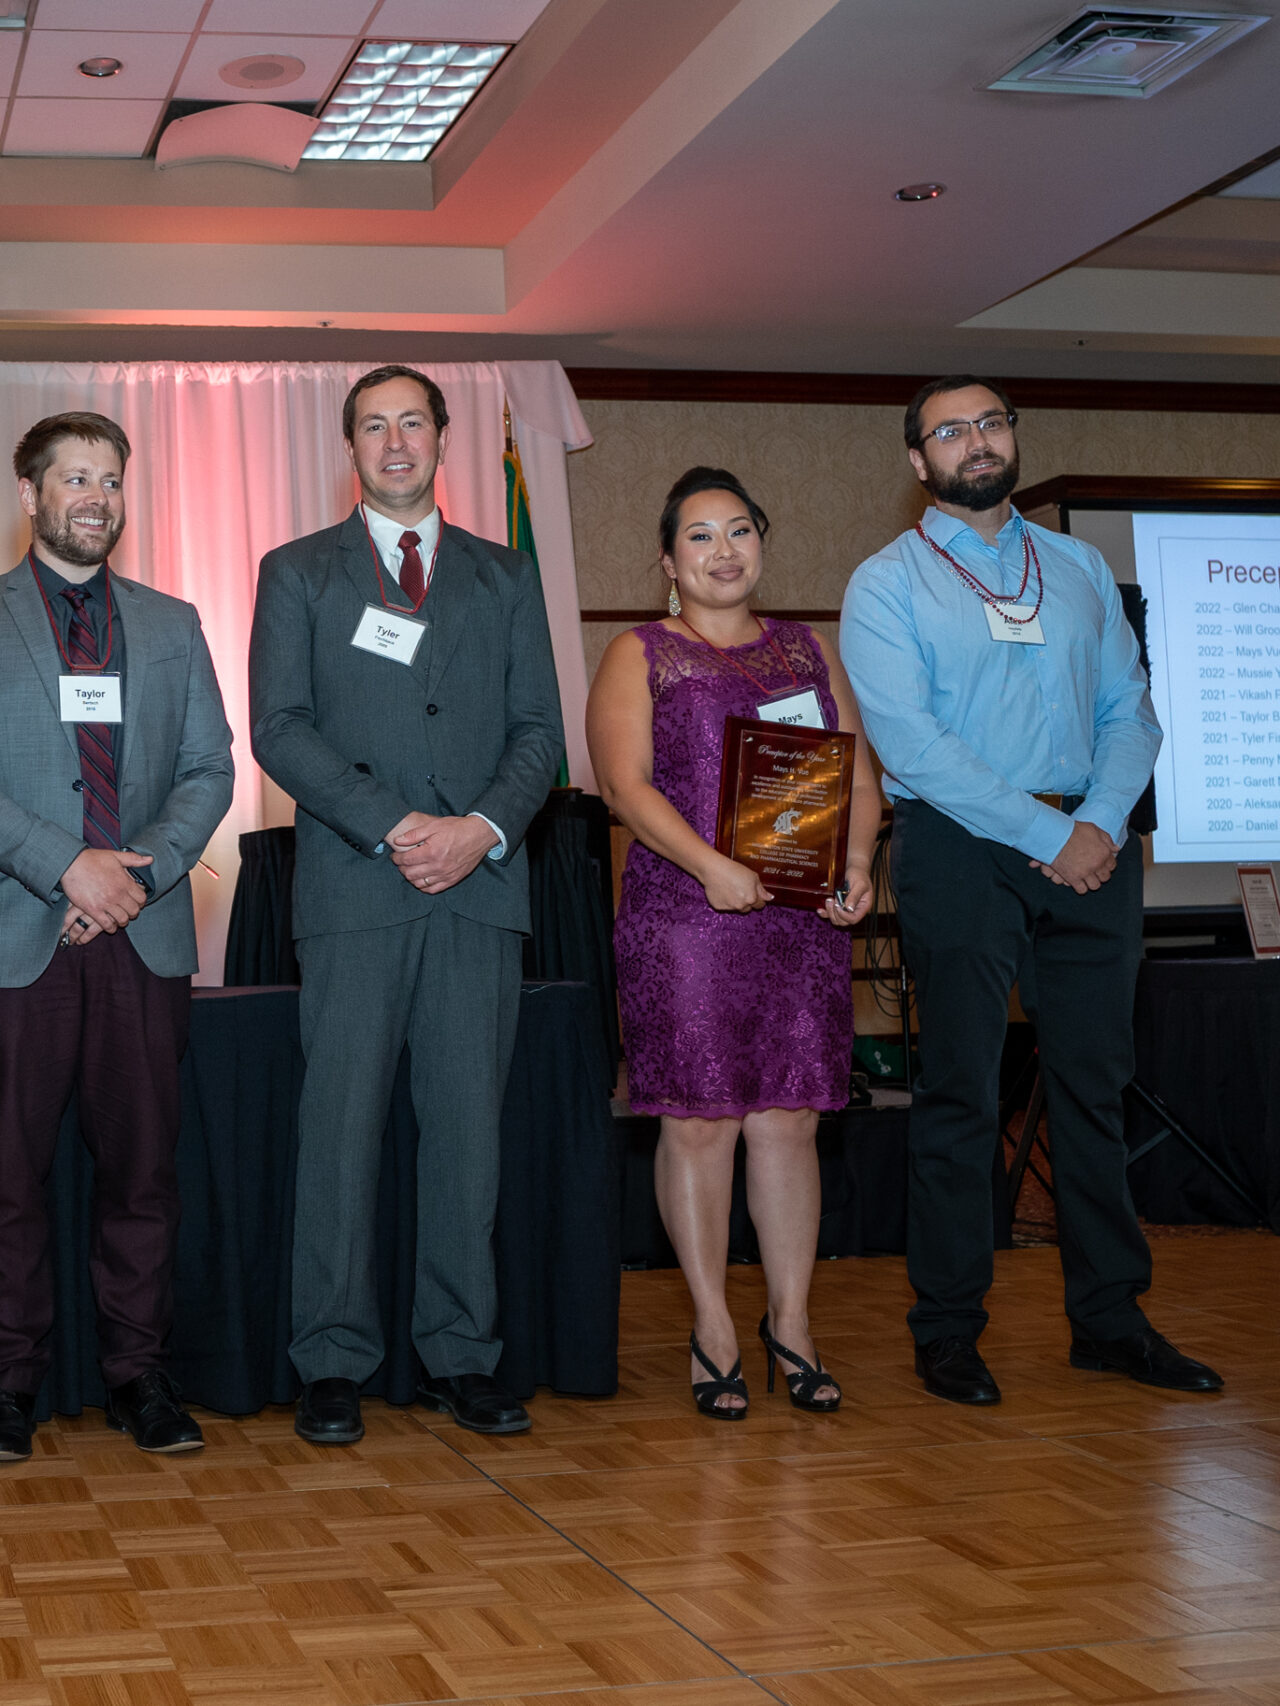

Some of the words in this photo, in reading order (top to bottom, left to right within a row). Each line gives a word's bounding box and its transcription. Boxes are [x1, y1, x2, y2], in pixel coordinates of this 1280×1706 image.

[1195, 602, 1221, 613] 2022
[1233, 602, 1257, 613] Glen
[377, 625, 400, 640] Tyler
[1197, 624, 1222, 635] 2022
[1234, 624, 1253, 635] Will
[1198, 646, 1224, 657] 2022
[1236, 646, 1263, 659] Mays
[1200, 667, 1225, 678] 2022
[1237, 667, 1273, 678] Mussie
[75, 689, 106, 699] Taylor
[1201, 689, 1225, 700] 2021
[1239, 689, 1272, 700] Vikash
[778, 713, 803, 725] Mays
[1202, 711, 1226, 722] 2021
[1240, 711, 1269, 724] Taylor
[1203, 733, 1228, 744] 2021
[1241, 732, 1265, 746] Tyler
[1204, 754, 1229, 766] 2021
[1242, 754, 1274, 767] Penny
[1206, 776, 1230, 788] 2021
[1243, 776, 1275, 788] Garett
[1207, 799, 1233, 810] 2020
[1208, 820, 1234, 832] 2020
[1246, 820, 1278, 832] Daniel
